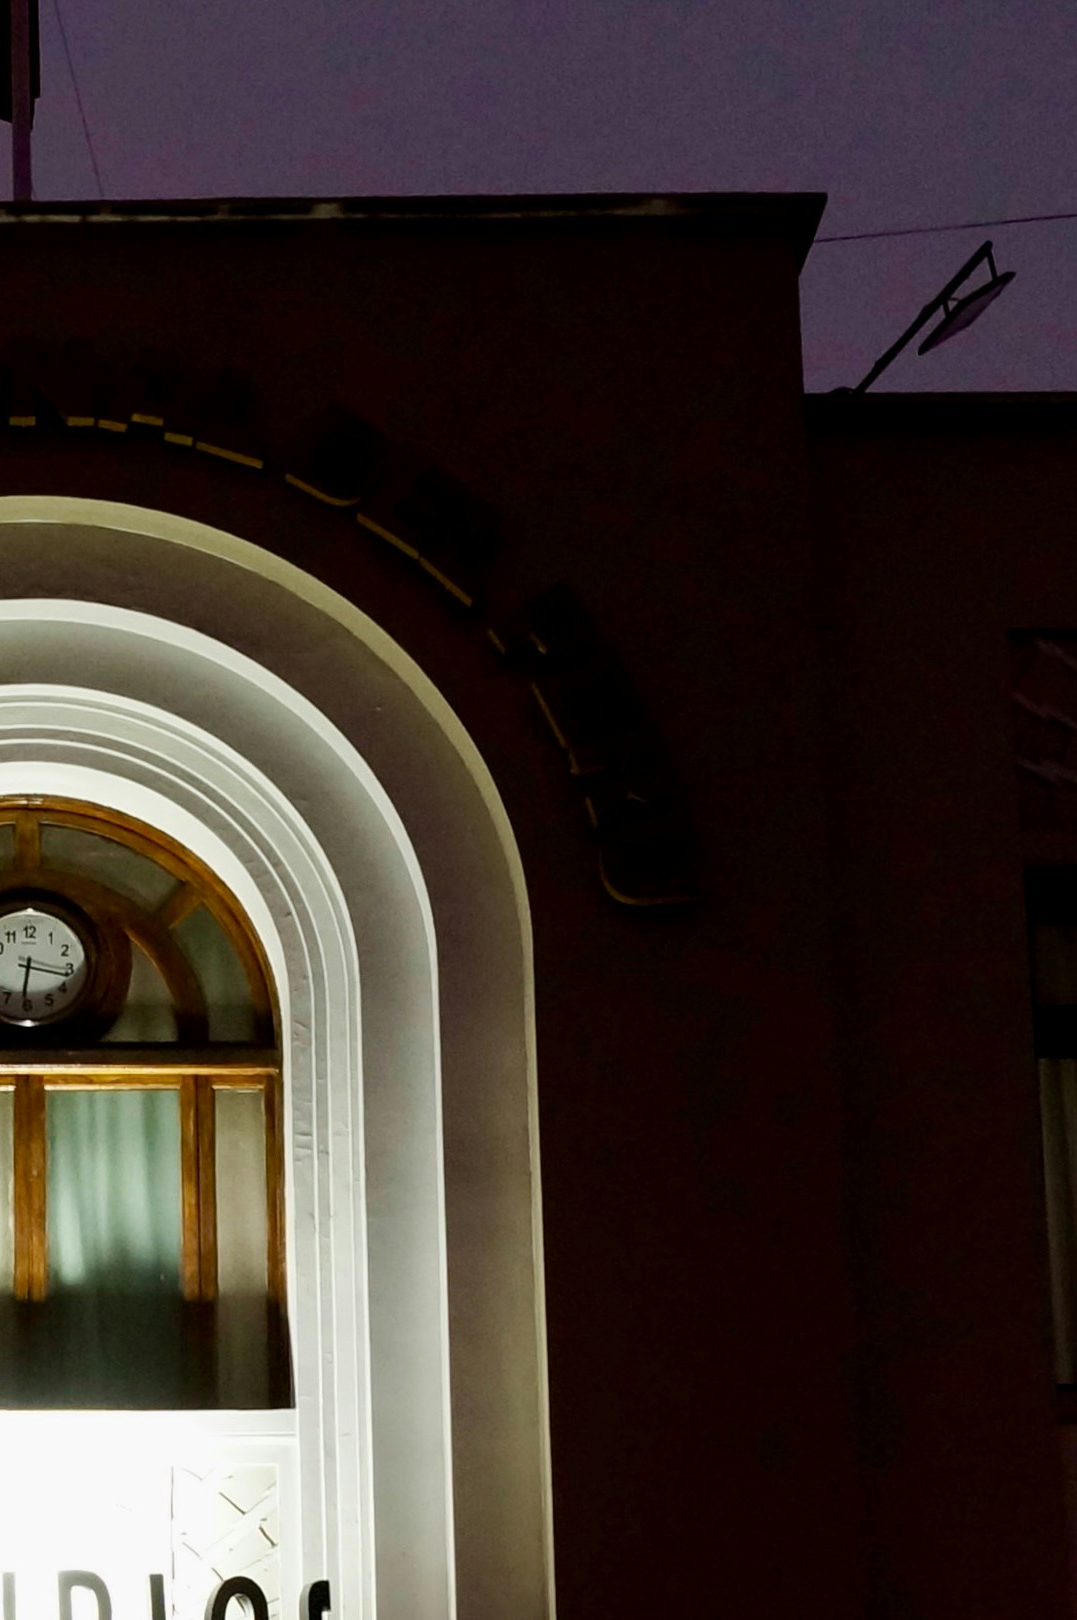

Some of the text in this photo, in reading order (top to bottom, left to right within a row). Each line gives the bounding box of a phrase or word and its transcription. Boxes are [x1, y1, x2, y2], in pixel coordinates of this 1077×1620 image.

[5, 930, 16, 943] 11
[23, 925, 37, 939] 12
[48, 932, 53, 945] 1
[60, 944, 69, 957] 2
[65, 962, 74, 976] 3
[58, 981, 67, 993] 4
[2, 991, 12, 1004] 7
[45, 993, 54, 1006] 5
[22, 999, 33, 1012] 6
